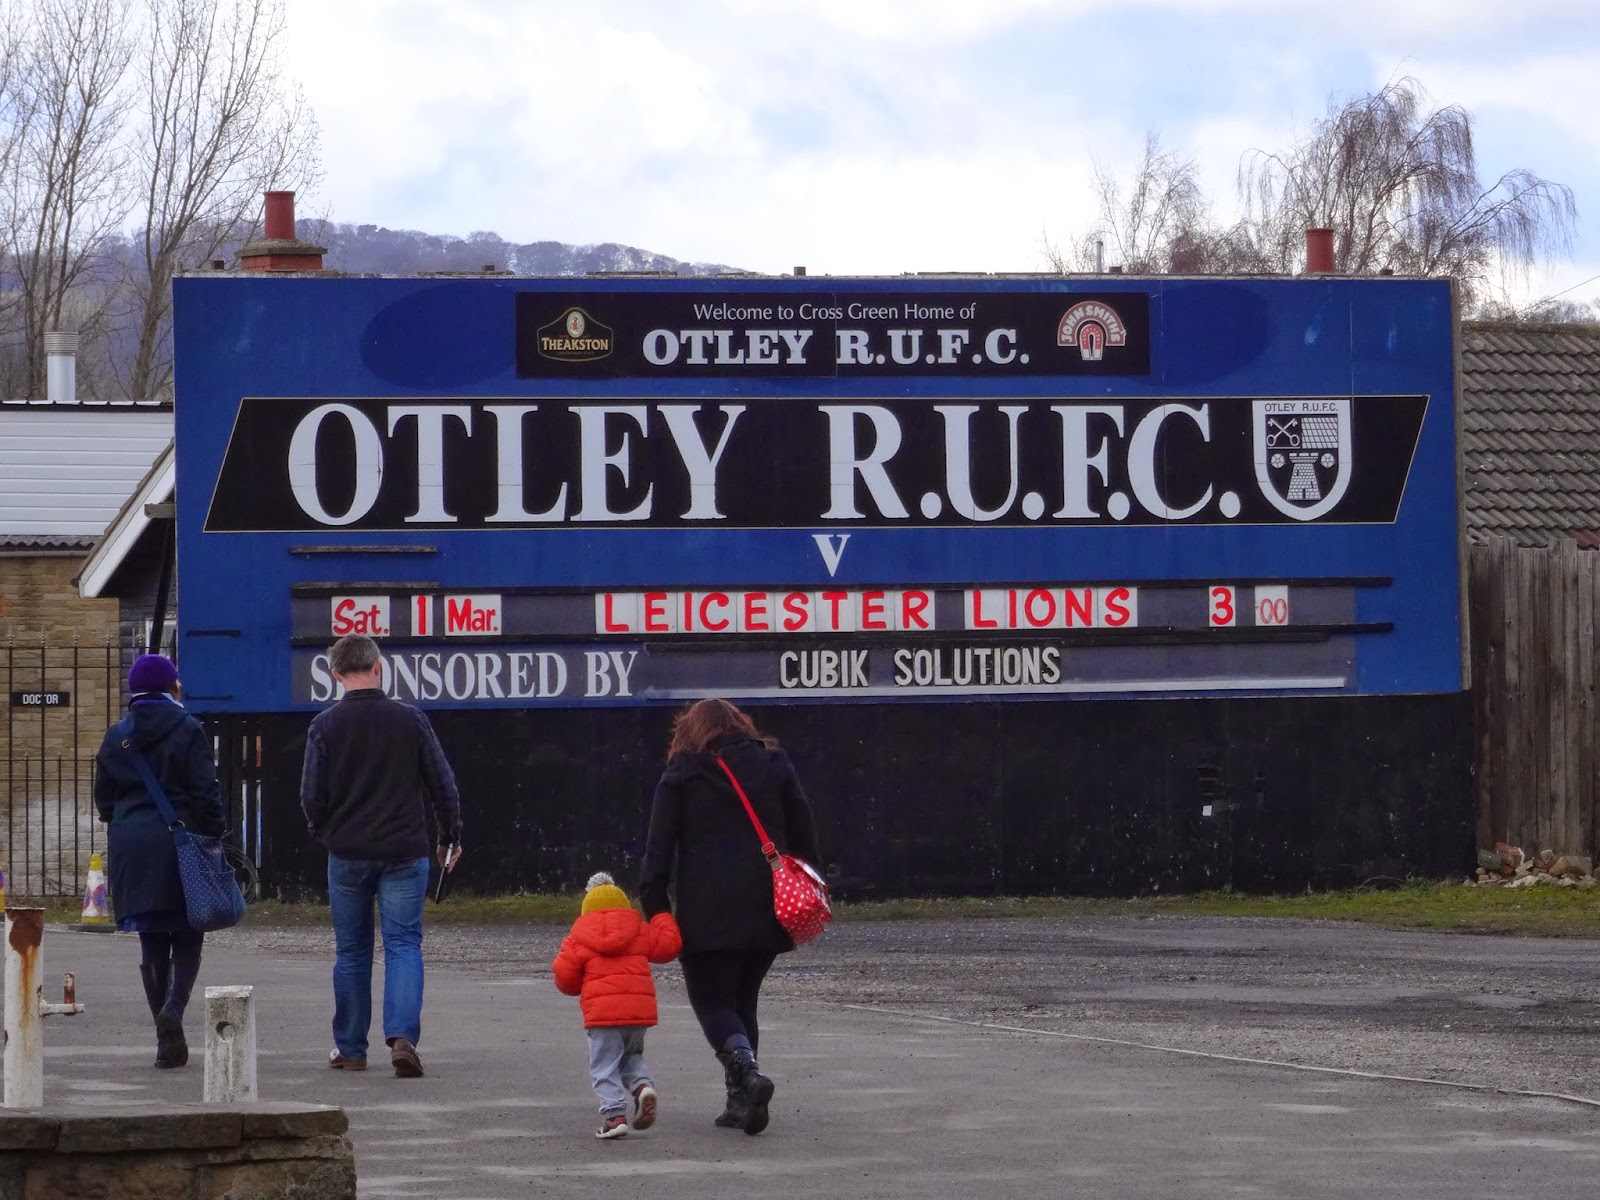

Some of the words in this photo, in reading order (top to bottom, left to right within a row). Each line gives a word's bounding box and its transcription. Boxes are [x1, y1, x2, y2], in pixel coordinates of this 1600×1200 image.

[694, 303, 772, 320] Welcome
[777, 305, 794, 320] to
[799, 303, 843, 320] Cross
[848, 303, 898, 320] Green
[904, 303, 955, 320] Home
[959, 303, 976, 320] of
[1061, 306, 1085, 343] JOHN
[541, 337, 609, 351] THEAKSTON
[642, 328, 813, 366] OTLEY
[836, 328, 1030, 365] R.U.F.C.
[1264, 403, 1296, 412] OTLEY
[1302, 403, 1339, 412] R.U.F.C.
[288, 402, 746, 526] OTLEY
[818, 402, 1241, 522] R.U.F.C.
[333, 599, 390, 635] Sat.
[448, 598, 498, 633] Mar.
[603, 590, 930, 632] LEICESTER
[972, 588, 1131, 629] LIONS
[1211, 587, 1234, 625] 3
[584, 650, 639, 698] BY
[780, 650, 870, 688] CUBIK
[894, 646, 1061, 686] SOLUTIONS
[22, 693, 59, 705] DOCOR
